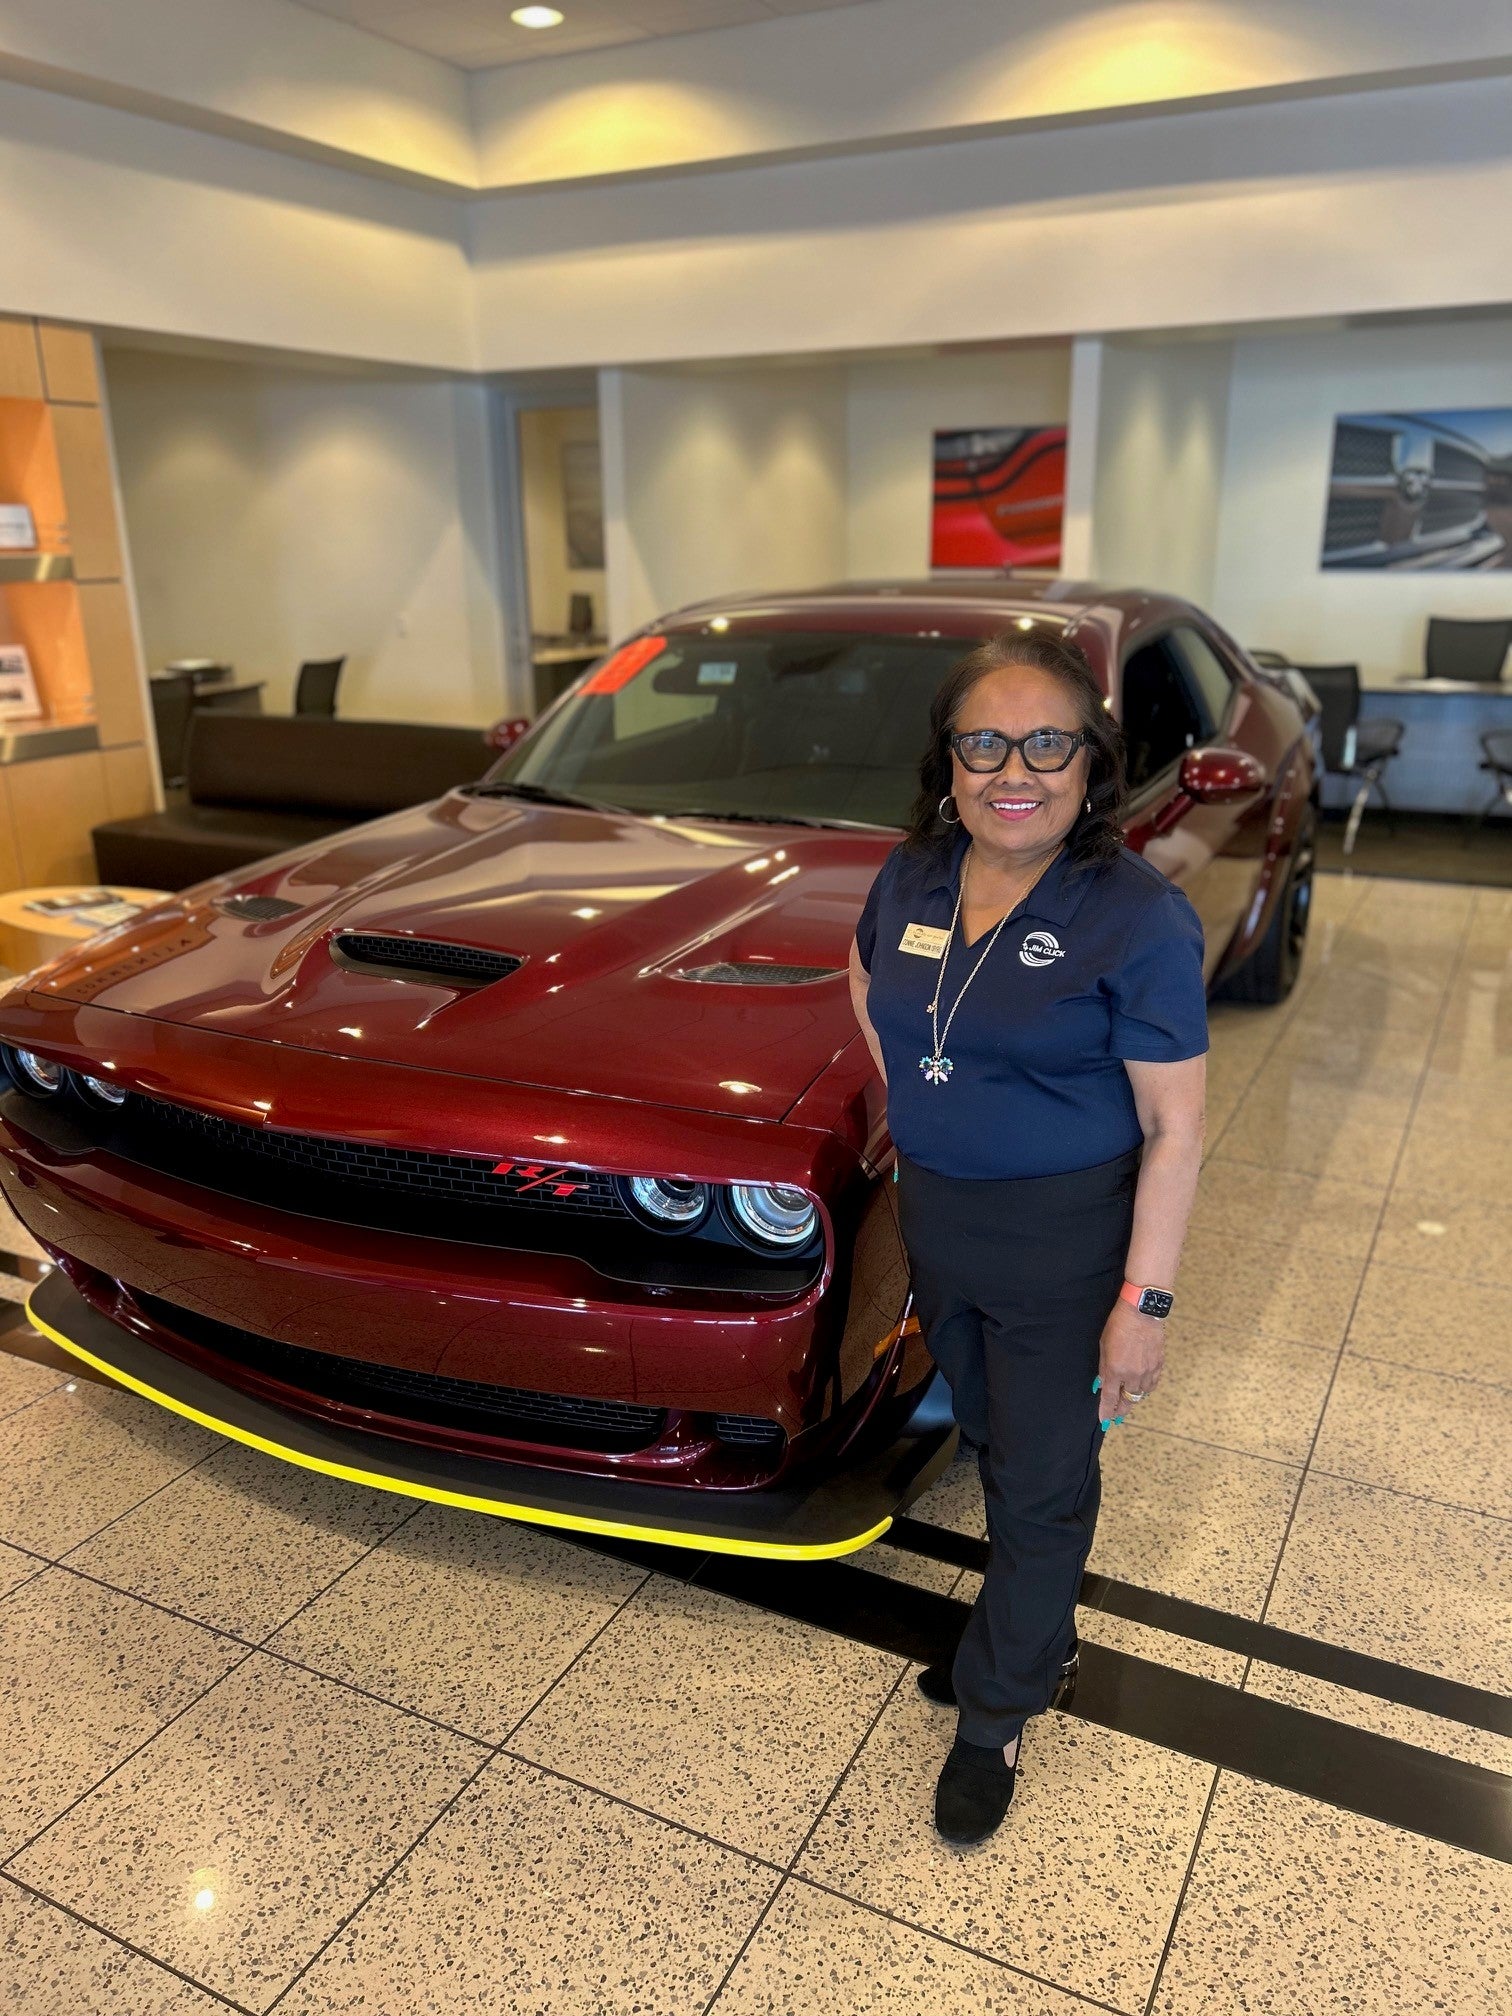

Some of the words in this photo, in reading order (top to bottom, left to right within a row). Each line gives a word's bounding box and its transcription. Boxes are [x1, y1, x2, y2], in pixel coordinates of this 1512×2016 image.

[1028, 944, 1043, 953] JIM
[1042, 947, 1067, 957] CLICK
[491, 1162, 591, 1197] R/T
